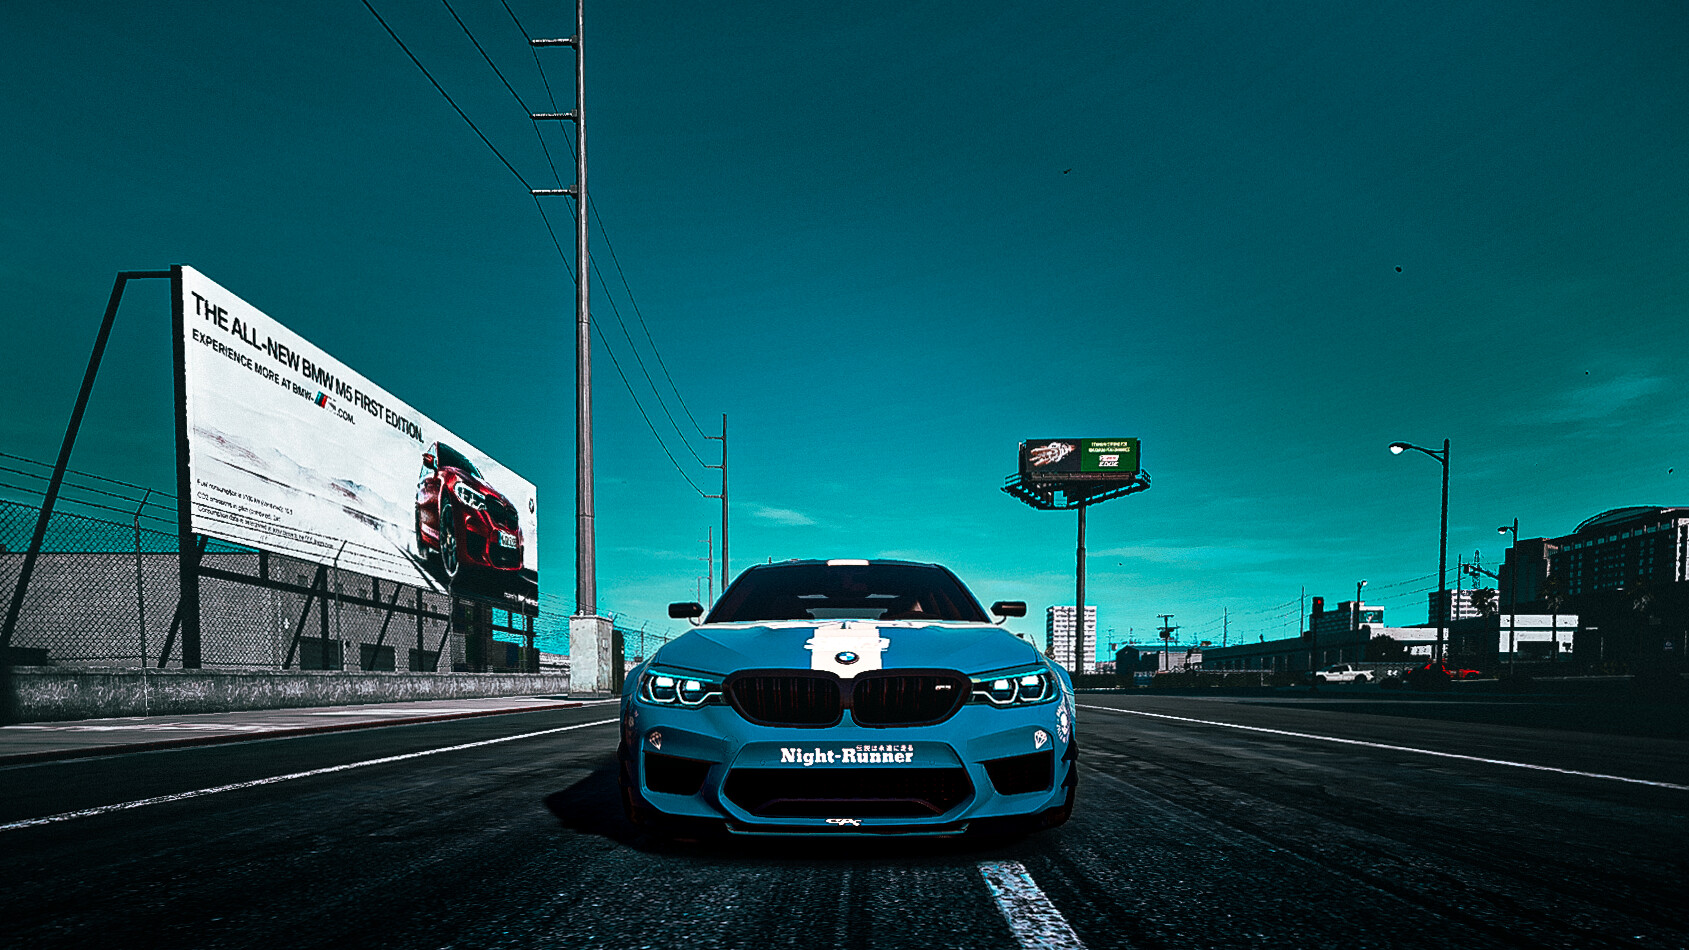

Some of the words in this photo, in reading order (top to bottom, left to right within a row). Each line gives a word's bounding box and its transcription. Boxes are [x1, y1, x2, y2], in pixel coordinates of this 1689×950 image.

[191, 290, 229, 332] THE
[231, 317, 300, 372] ALL-NEW
[302, 357, 334, 391] BMW
[335, 378, 353, 402] M5
[354, 388, 384, 419] FIRST
[385, 407, 425, 443] EDITION.
[192, 328, 253, 371] EXPERIENCE
[254, 362, 280, 384] MORE
[281, 377, 292, 392] AT
[780, 747, 914, 766] Night-Runner
